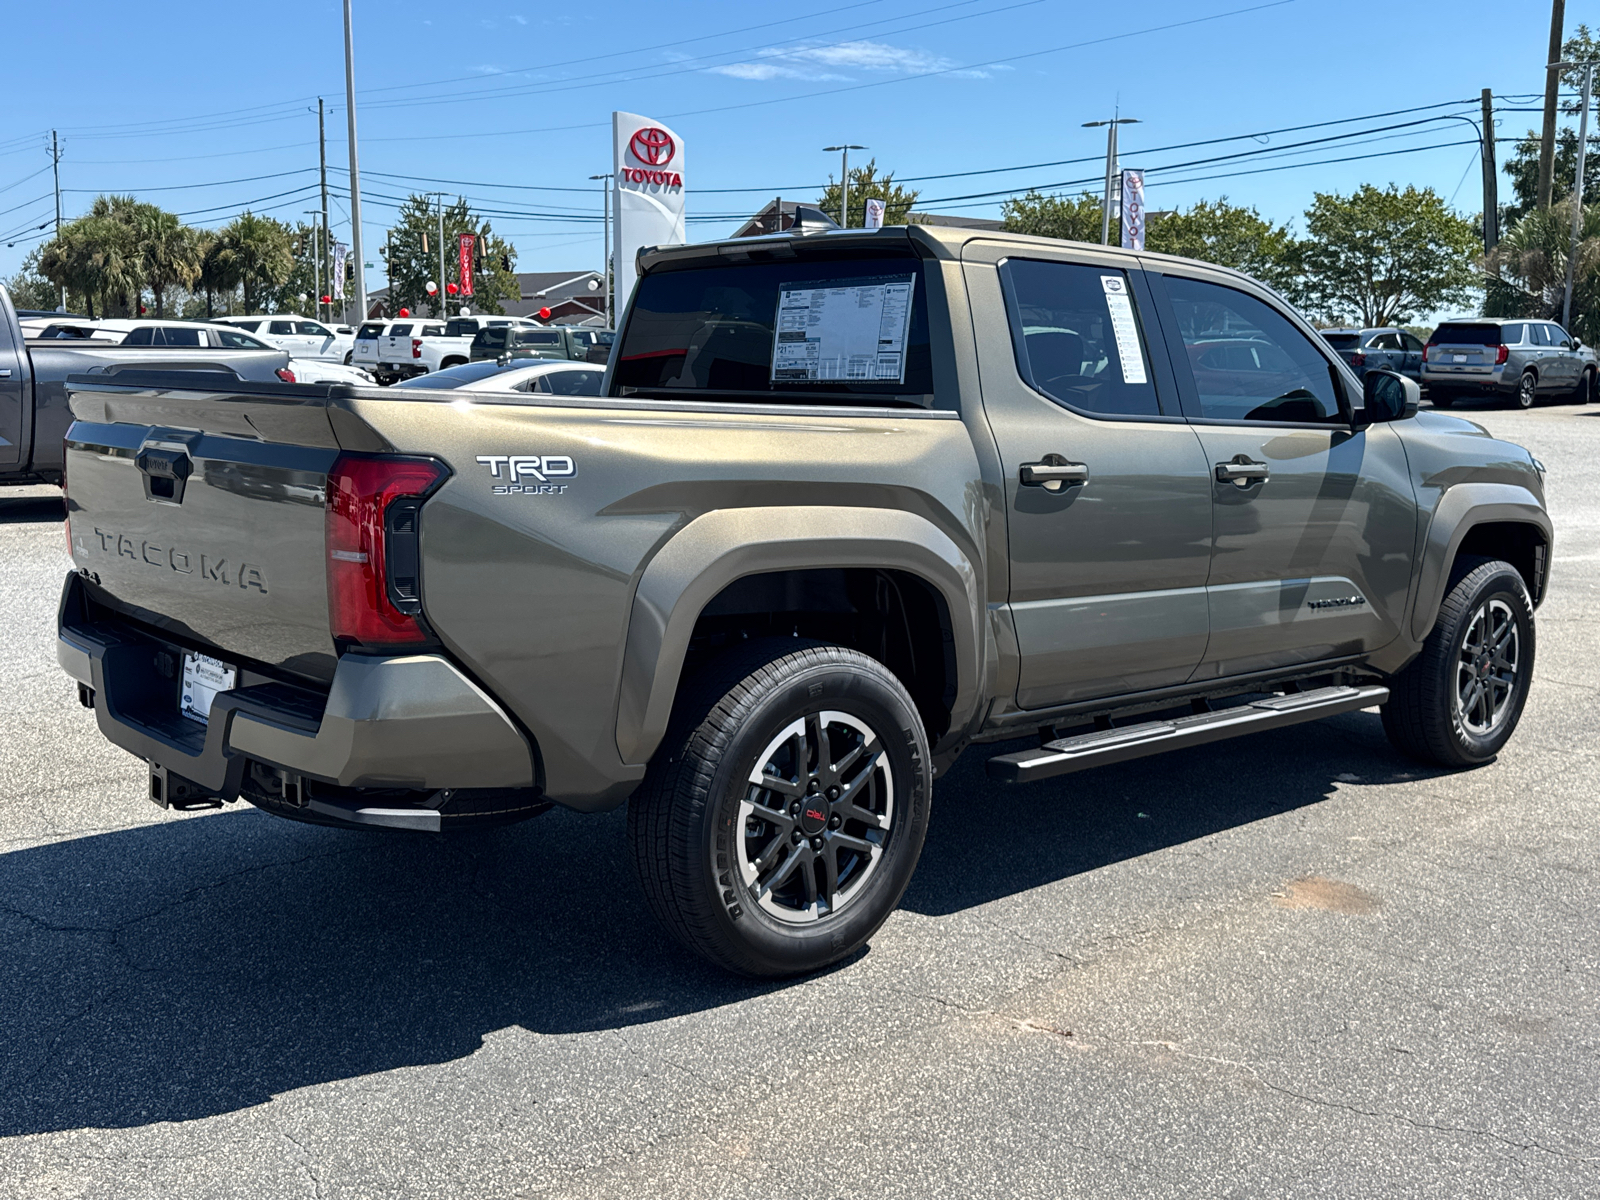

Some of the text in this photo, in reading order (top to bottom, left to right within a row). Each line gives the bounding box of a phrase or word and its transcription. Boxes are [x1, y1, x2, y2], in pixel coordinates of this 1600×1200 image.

[622, 168, 682, 187] TOYOTA
[1129, 191, 1139, 248] TOYOT
[476, 455, 578, 485] TRD
[491, 485, 568, 495] SPORT
[94, 527, 268, 594] TACOMA
[902, 728, 924, 839] GENERAL
[806, 808, 826, 822] TRD
[716, 796, 744, 921] GRABBER
